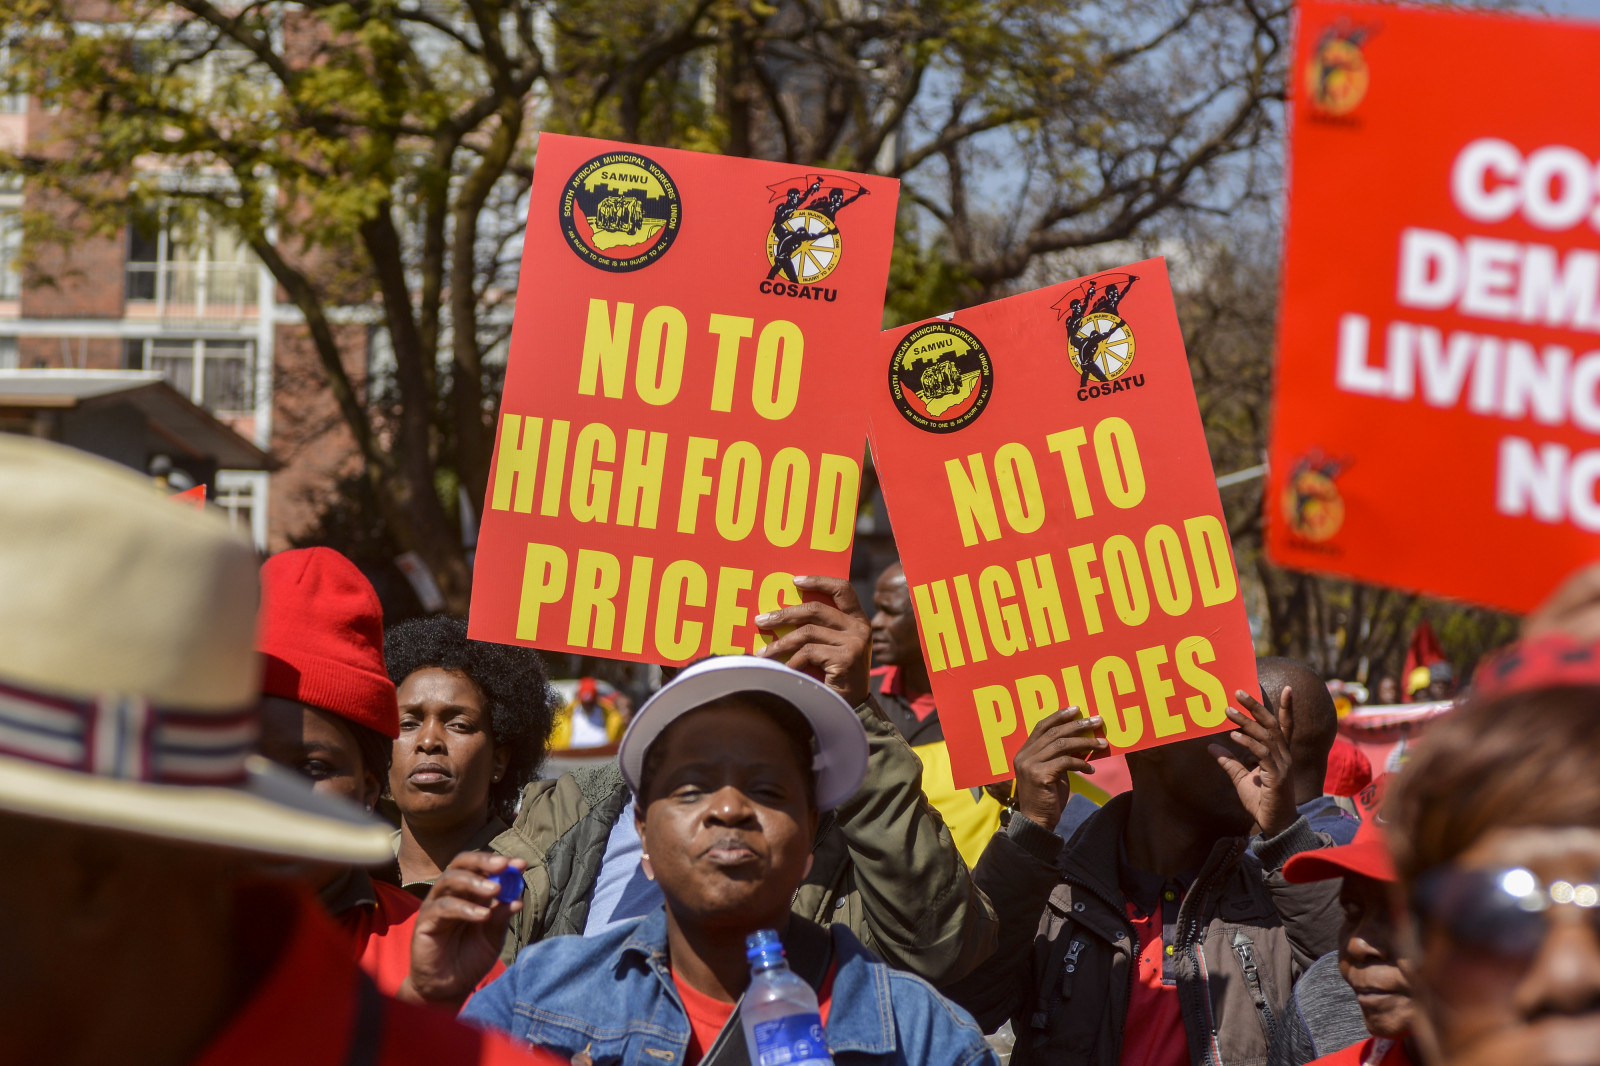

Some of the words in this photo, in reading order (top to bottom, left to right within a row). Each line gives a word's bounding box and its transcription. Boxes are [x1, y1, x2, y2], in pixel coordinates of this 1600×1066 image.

[564, 189, 575, 217] SOUTH
[572, 160, 600, 188] AFRICAN
[603, 154, 645, 167] MUNICIPAL
[669, 204, 677, 229] UNION
[601, 171, 648, 184] SAMWU
[1452, 137, 1600, 234] CO
[573, 239, 589, 255] INJURY
[598, 257, 610, 265] ONE
[629, 255, 648, 265] INJURY
[649, 249, 657, 257] TO
[657, 241, 667, 252] ALL
[760, 281, 837, 302] COSATU
[1398, 227, 1600, 335] DEM
[909, 324, 945, 342] MUNICIPAL
[913, 338, 953, 355] SAMWU
[577, 298, 688, 406] NO
[708, 313, 805, 421] TO
[893, 341, 910, 371] AFRICAN
[979, 352, 990, 376] UNION
[892, 374, 903, 400] SOUTH
[1077, 374, 1145, 401] COSATU
[963, 406, 978, 420] INJURY
[981, 389, 989, 399] ALL
[491, 413, 668, 530] HIGH
[676, 436, 860, 553] FOOD
[944, 442, 1046, 547] NO
[1046, 416, 1146, 520] TO
[912, 553, 1071, 673] HIGH
[1068, 514, 1238, 636] FOOD
